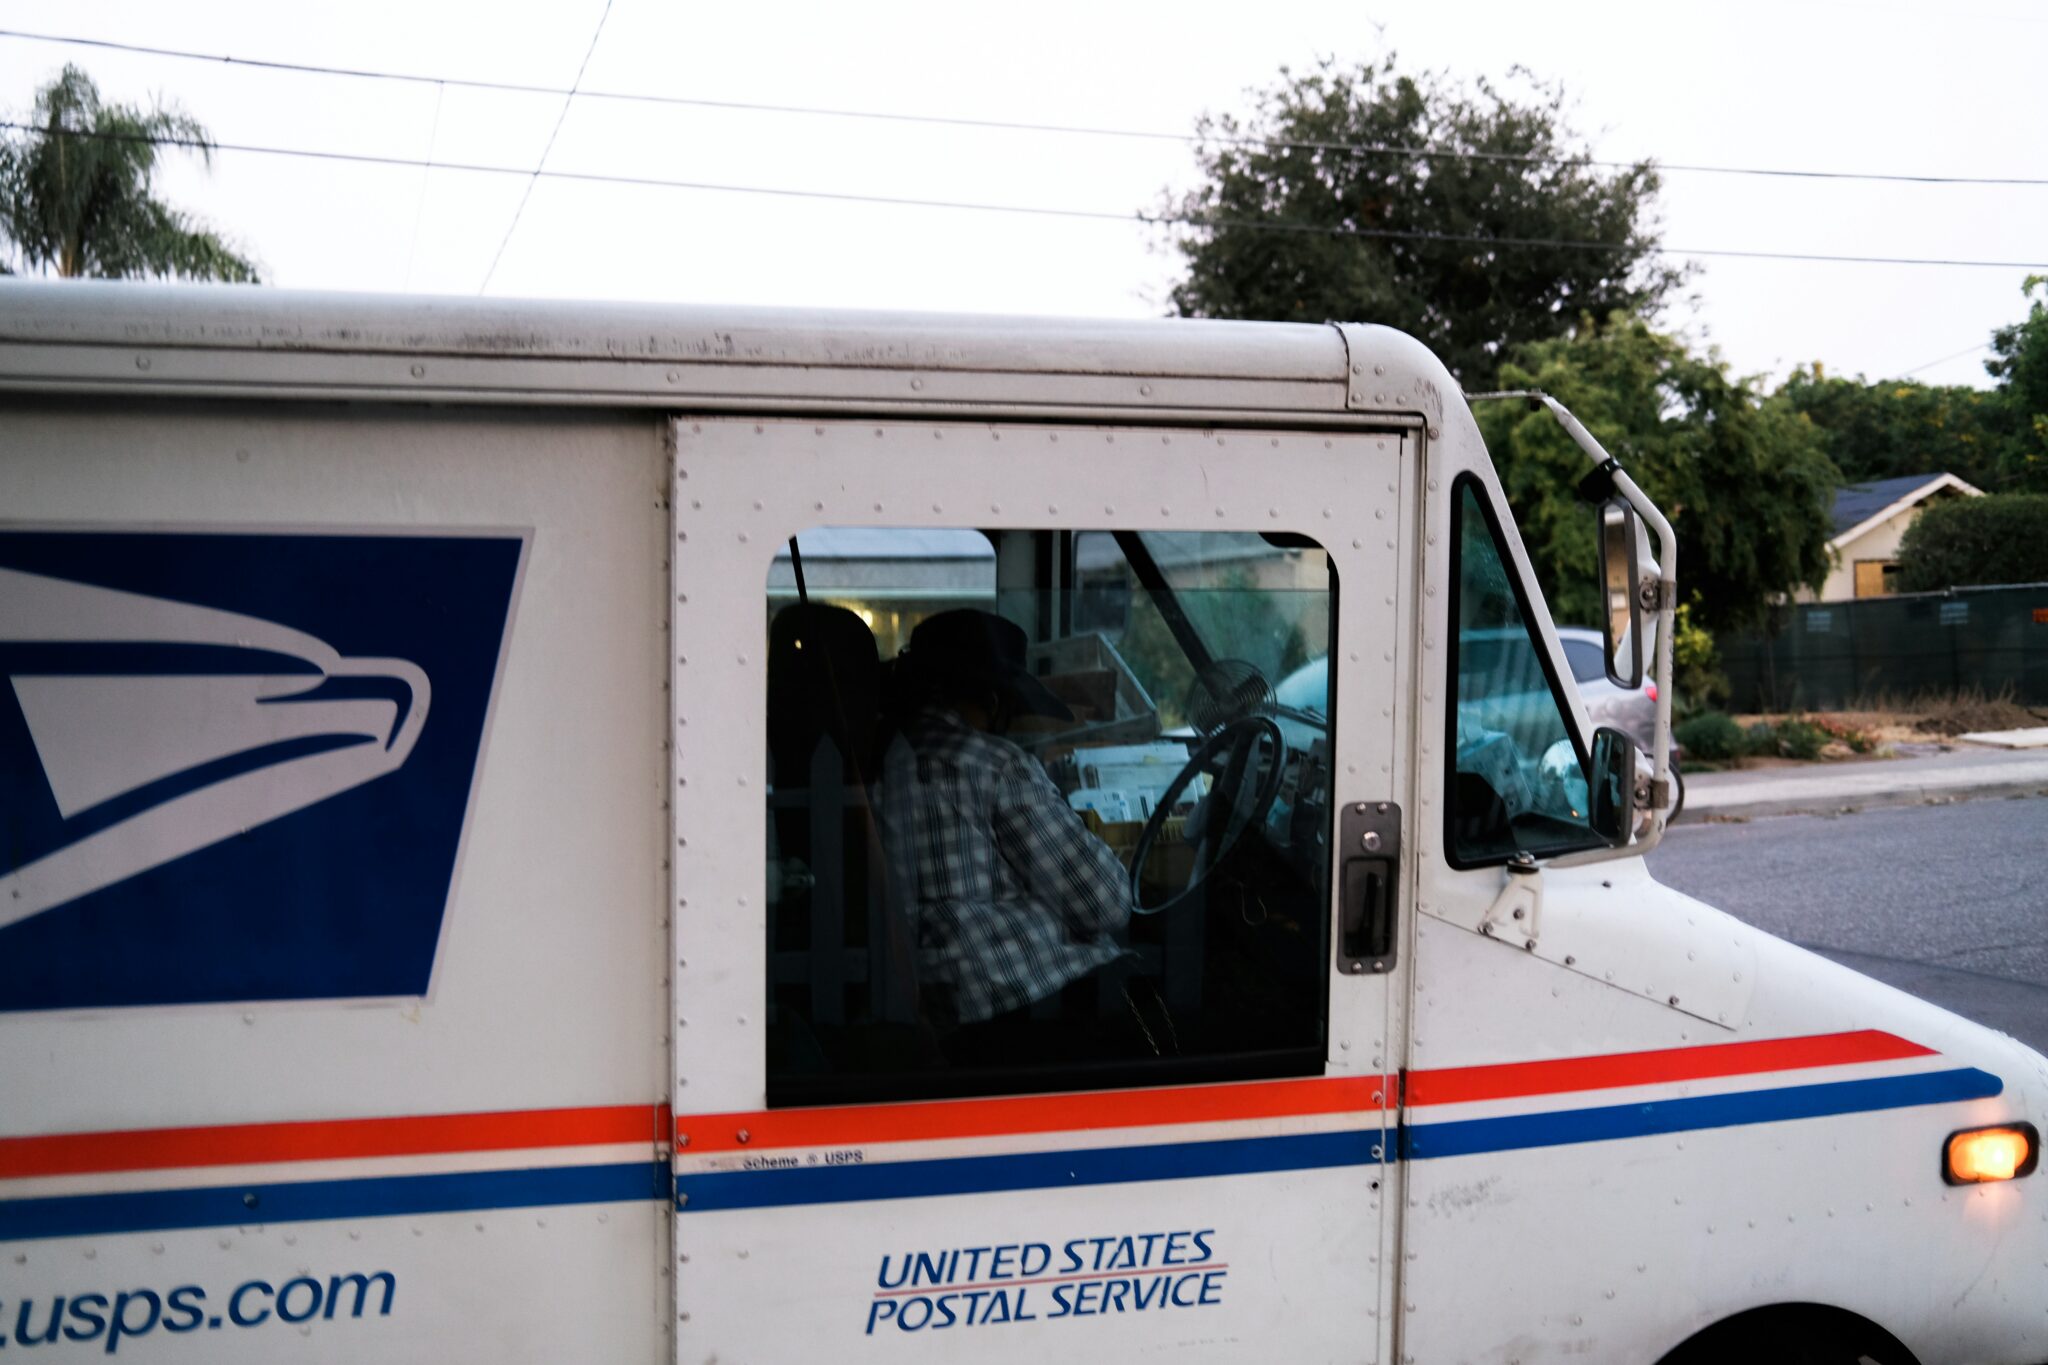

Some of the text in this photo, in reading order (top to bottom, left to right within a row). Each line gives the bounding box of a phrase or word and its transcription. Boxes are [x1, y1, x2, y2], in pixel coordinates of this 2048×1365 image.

[825, 1149, 864, 1164] USPS
[877, 1229, 1215, 1289] UNITED STATES
[865, 1271, 1227, 1335] POSTAL SERVICE
